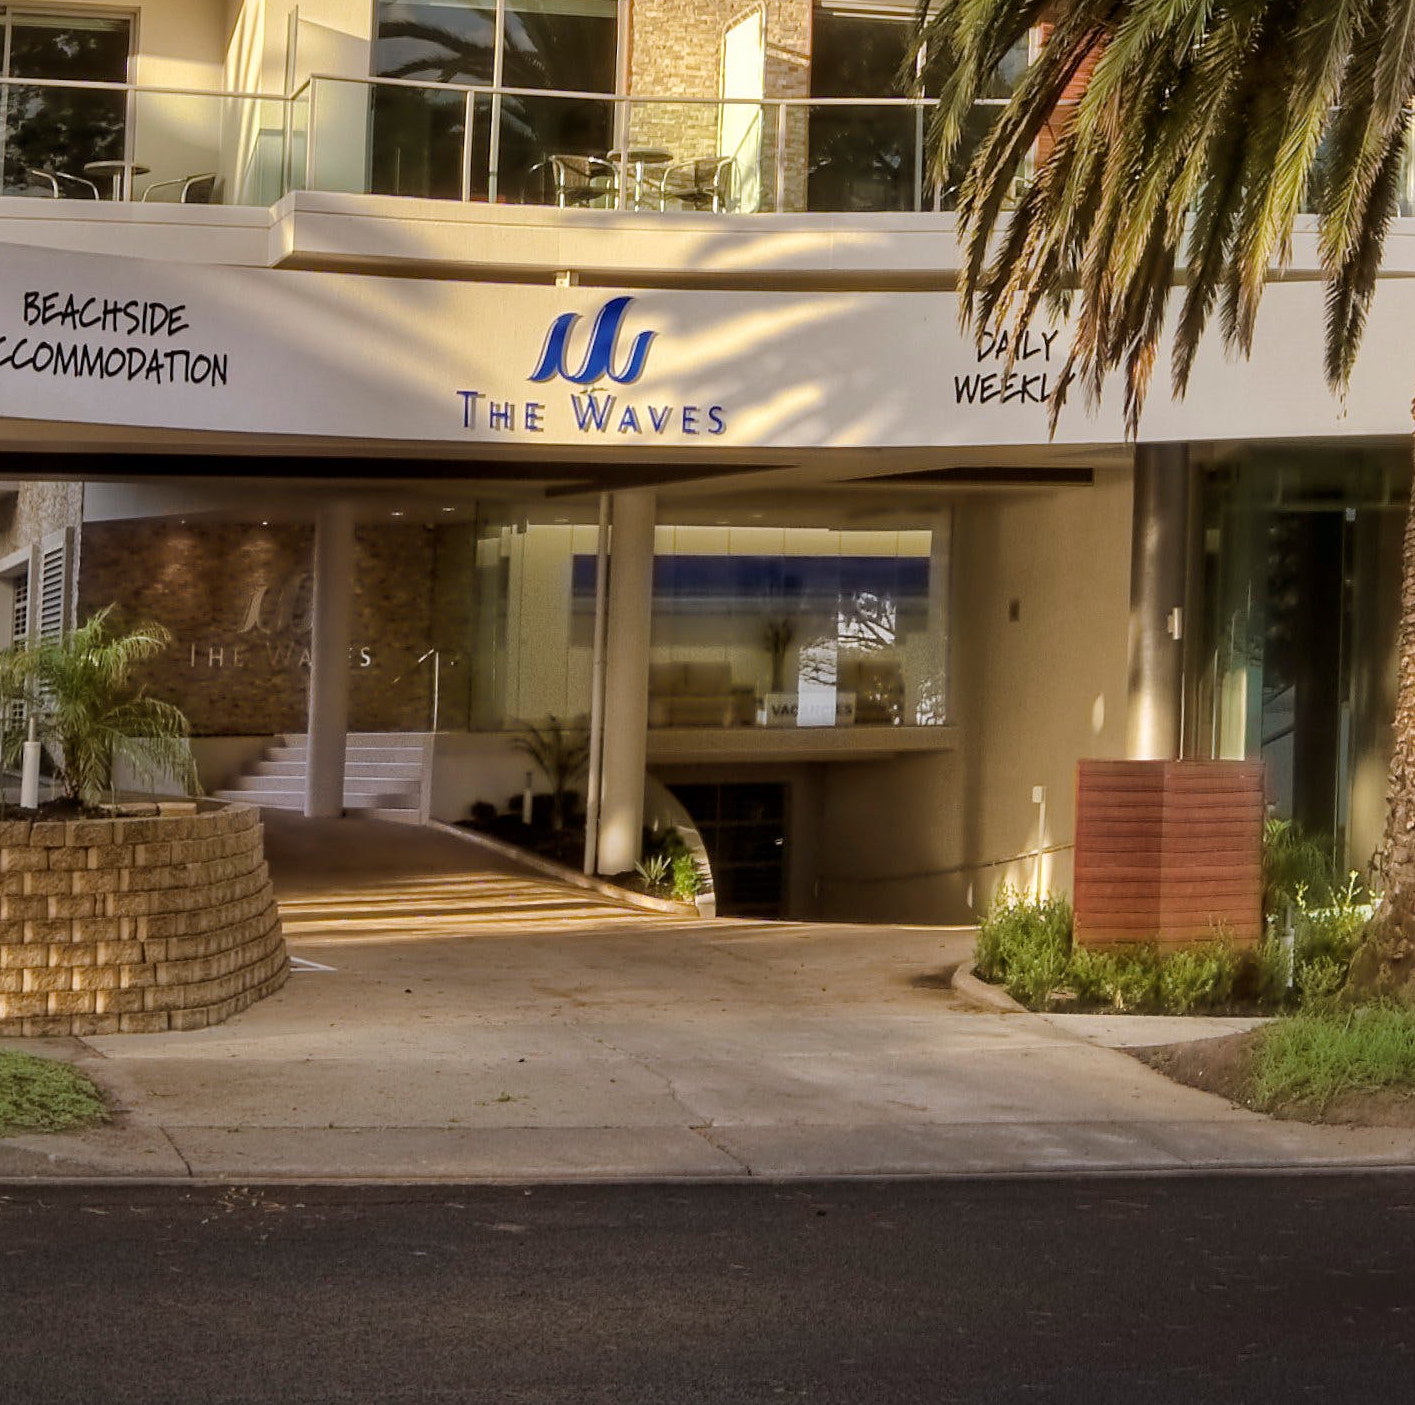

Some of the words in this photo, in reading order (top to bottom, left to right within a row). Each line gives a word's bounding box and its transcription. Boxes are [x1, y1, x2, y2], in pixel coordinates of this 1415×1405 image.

[23, 291, 189, 336] BEACHSIDE
[976, 329, 1059, 363] DAILY
[954, 372, 1076, 405] WEEKLY
[456, 390, 542, 431] THE
[571, 393, 727, 434] WAVES
[266, 642, 372, 668] WAS
